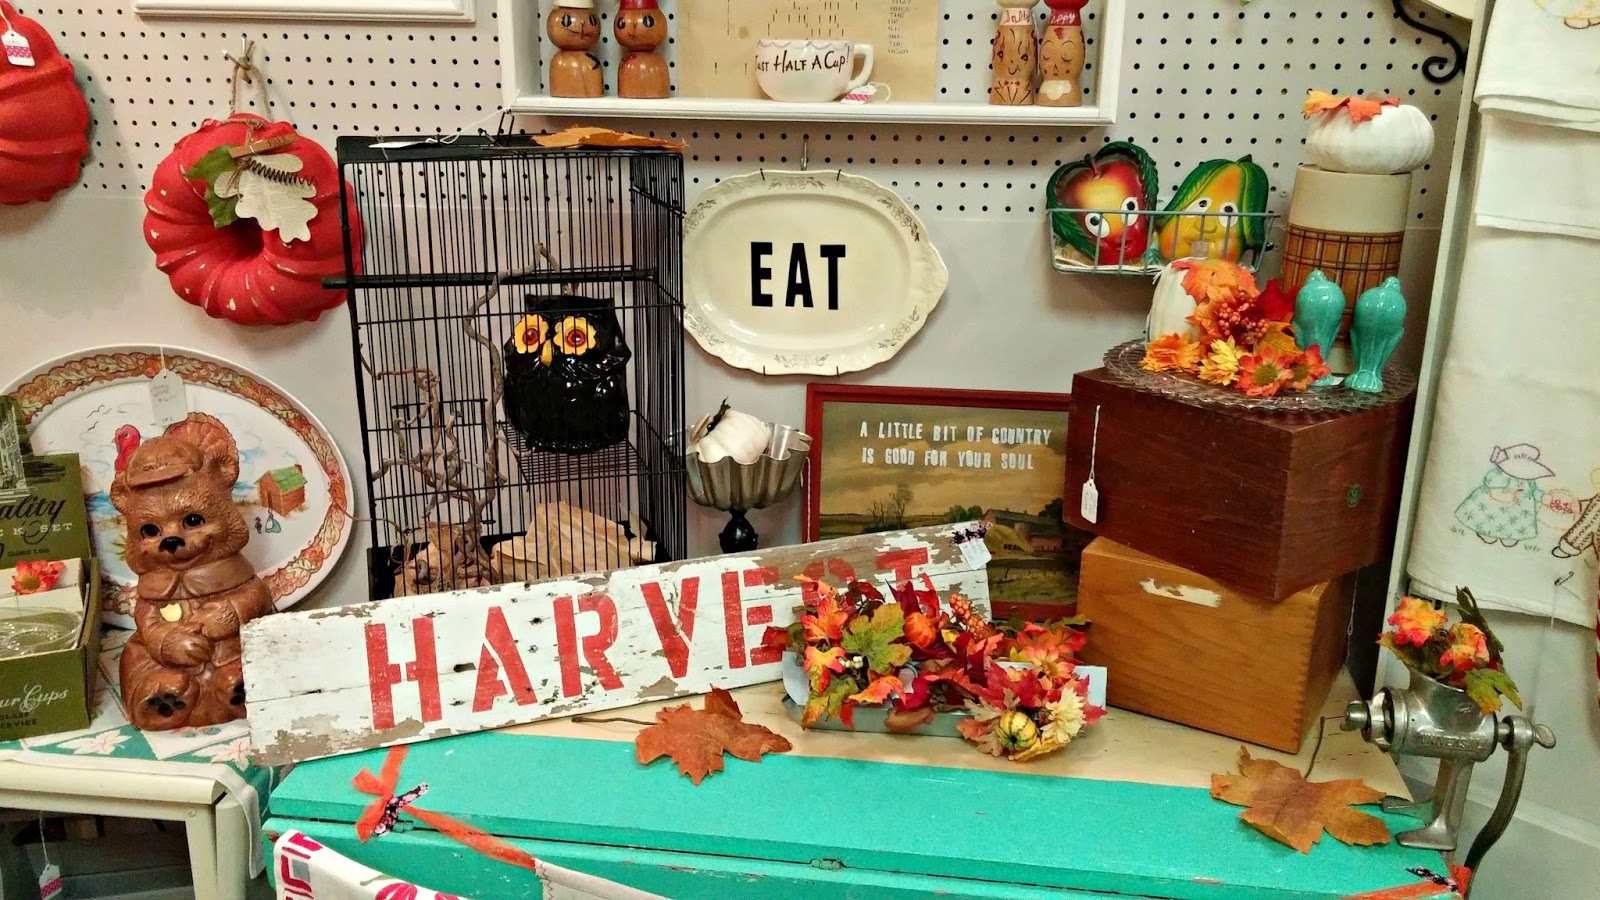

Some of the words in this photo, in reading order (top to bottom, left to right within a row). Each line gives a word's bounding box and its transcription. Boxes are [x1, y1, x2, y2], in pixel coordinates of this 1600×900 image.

[812, 55, 822, 69] A
[750, 241, 846, 310] EAT
[859, 421, 868, 438] A
[878, 421, 924, 440] LITTLE
[932, 425, 957, 442] BIT
[966, 426, 985, 443] OF
[991, 427, 1052, 445] COUNTRY
[861, 447, 875, 464] IS
[884, 448, 915, 466] GOOD
[924, 449, 948, 468] FOR
[958, 449, 992, 469] YOUR
[1000, 452, 1034, 470] SOUL
[40, 522, 73, 533] SET
[19, 683, 69, 713] Cups
